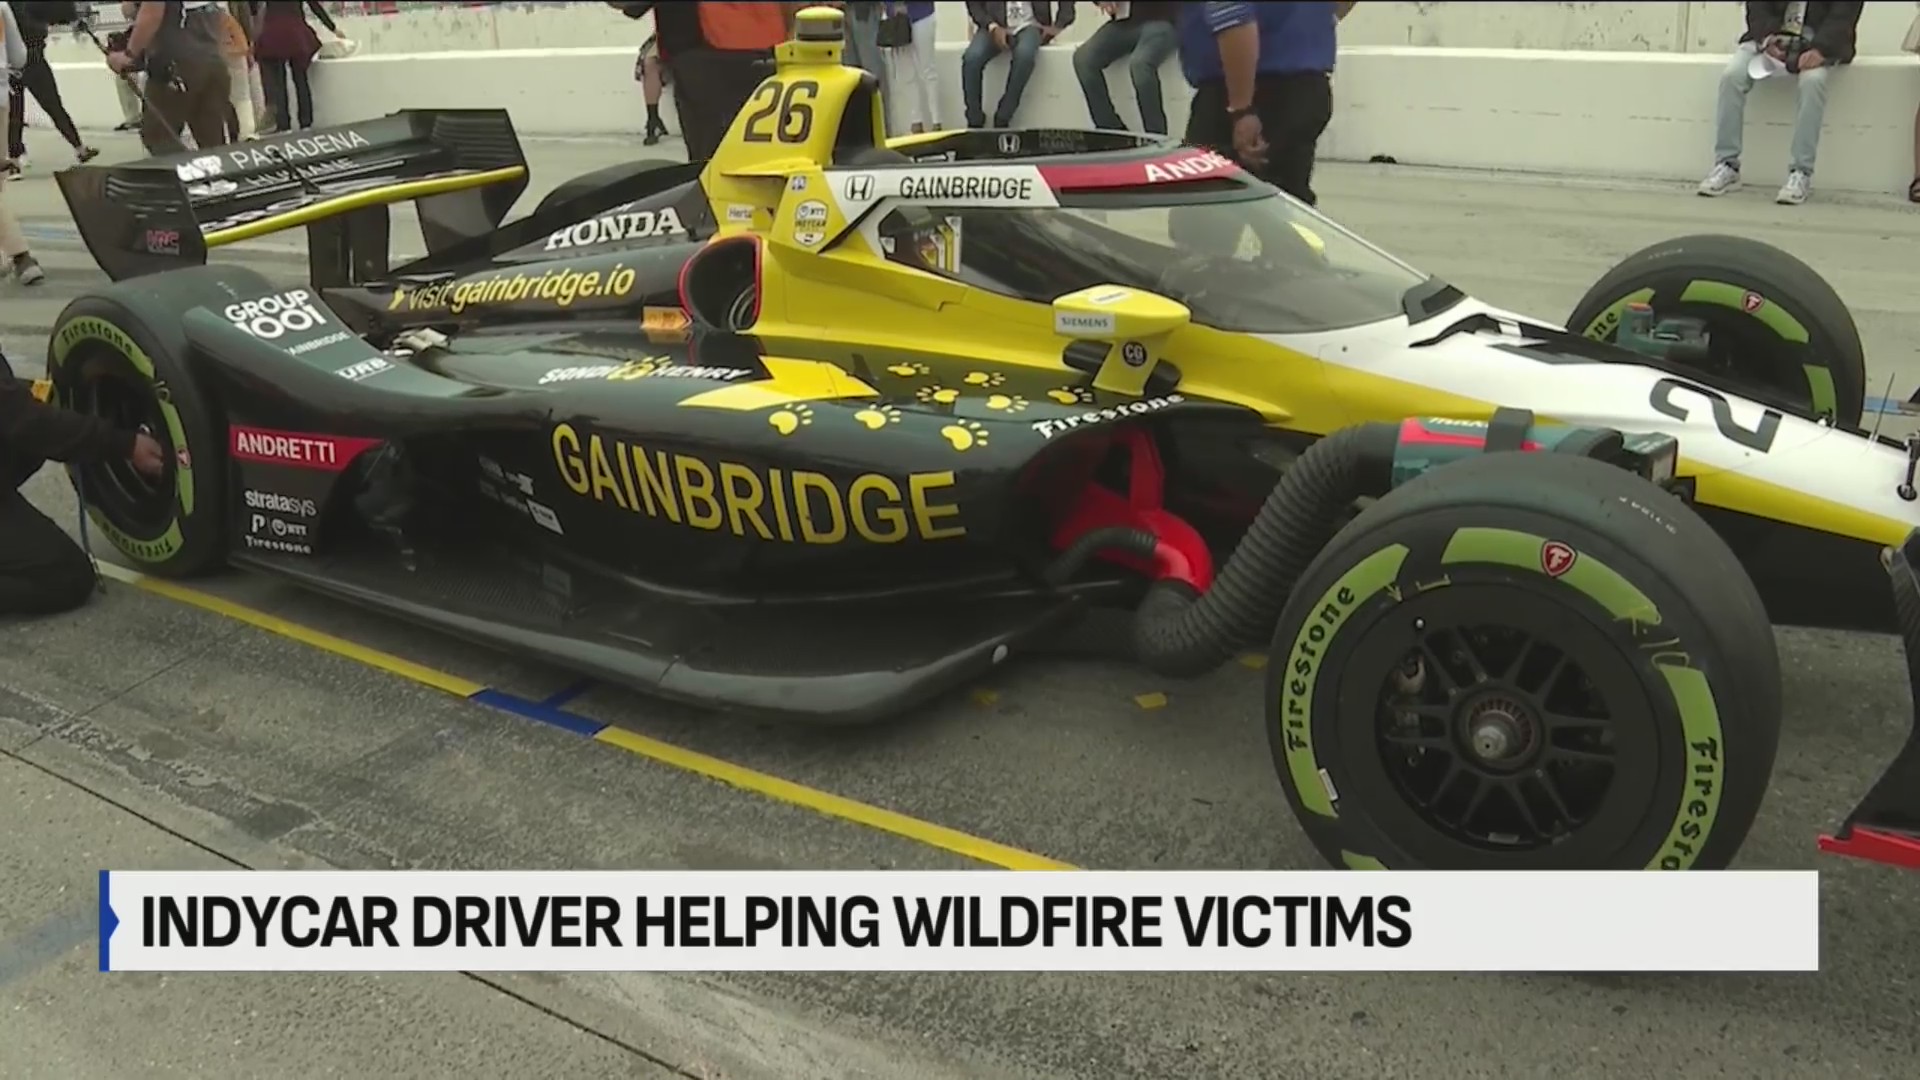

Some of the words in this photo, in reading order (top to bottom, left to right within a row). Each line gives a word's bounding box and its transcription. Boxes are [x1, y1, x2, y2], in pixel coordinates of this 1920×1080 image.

[743, 81, 819, 142] 26
[899, 175, 1033, 200] GAINBRIDGE
[544, 206, 687, 250] HONDA
[409, 281, 456, 310] visit
[452, 263, 636, 314] gainbridge.io
[224, 289, 310, 323] GROUP
[1061, 317, 1108, 328] SIEMENS
[62, 321, 133, 354] Firestone
[1125, 344, 1144, 361] CG
[1032, 391, 1186, 440] Firestone
[237, 431, 336, 464] ANDRETTI
[552, 422, 968, 546] GAINBRIDGE
[244, 489, 317, 517] stratasys
[244, 535, 312, 555] Firestone
[1286, 586, 1355, 753] Firestone
[1661, 736, 1719, 871] Firesto
